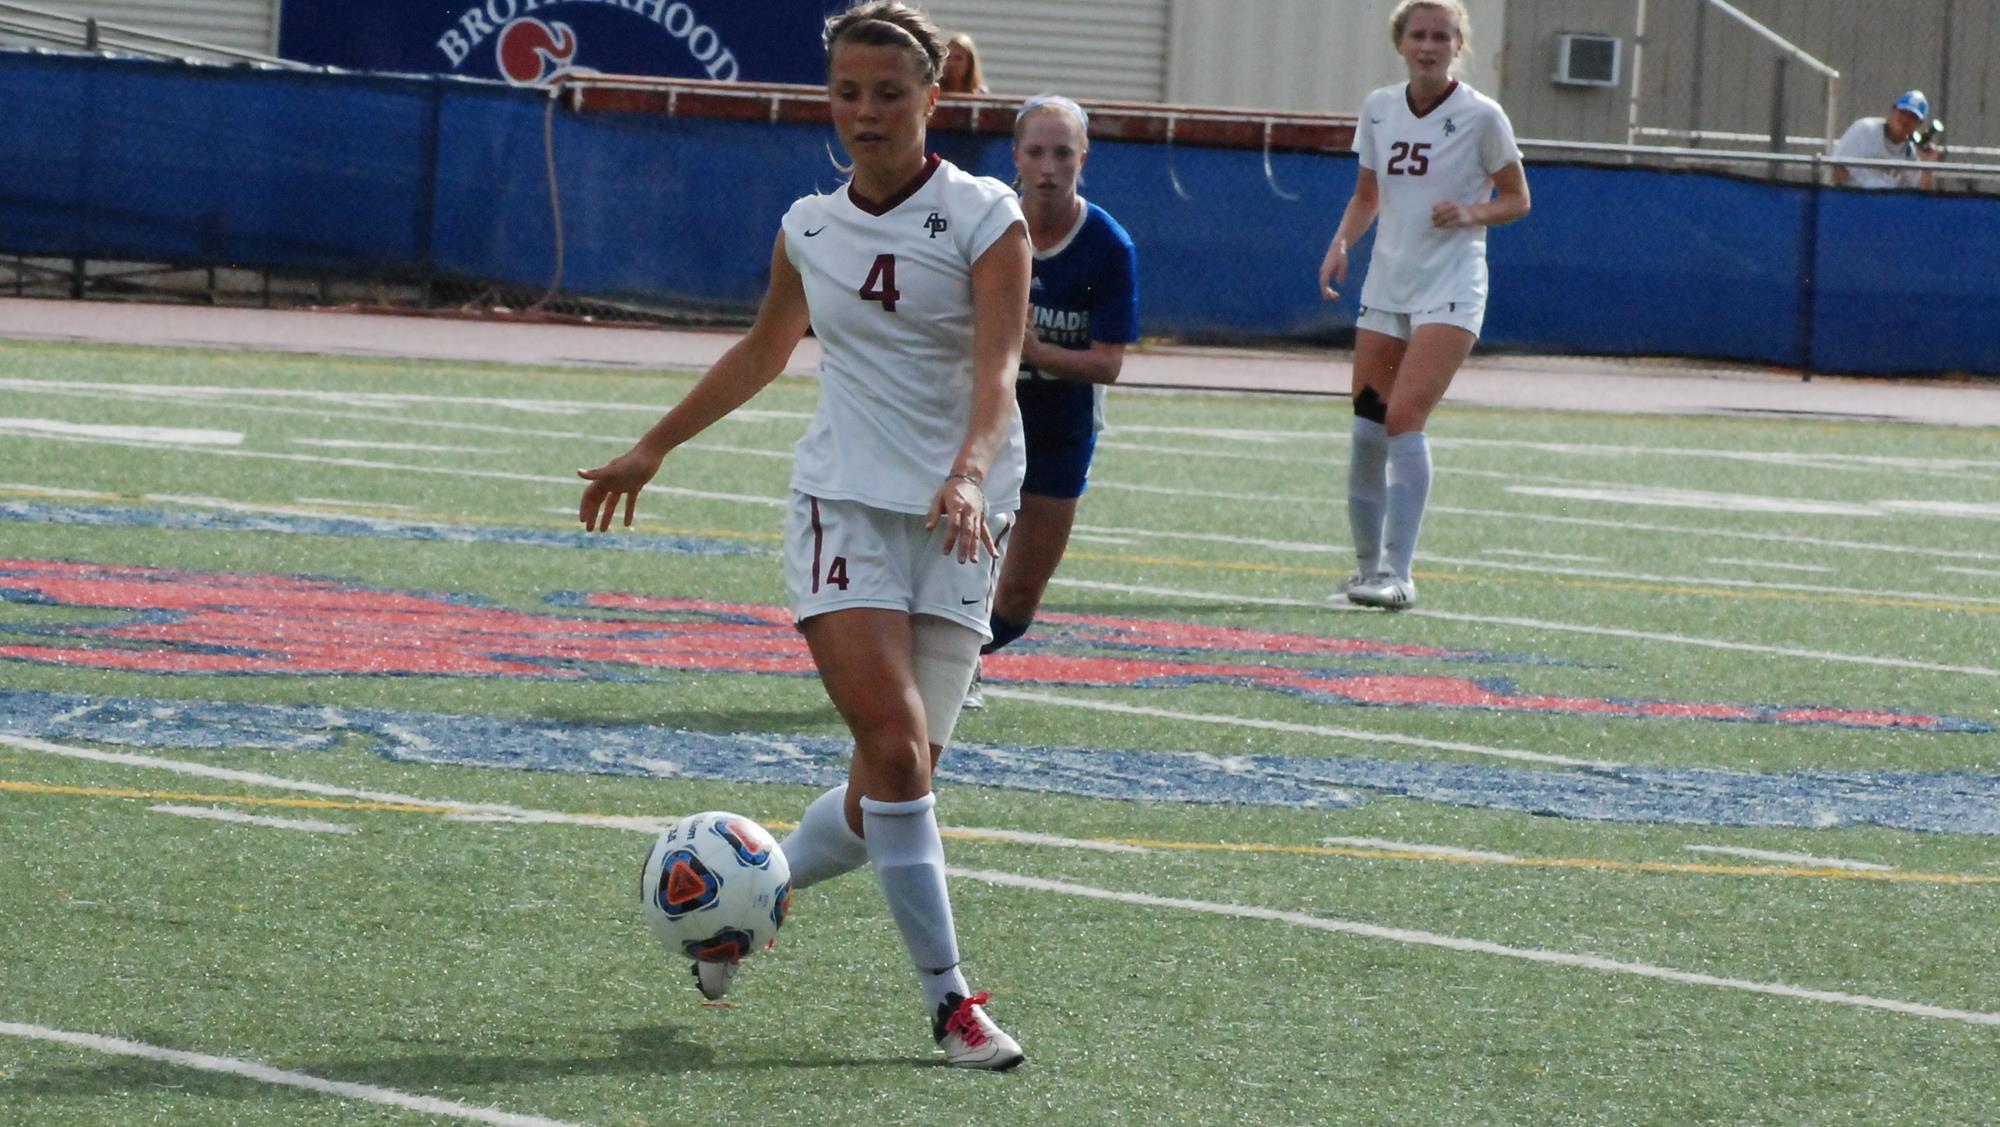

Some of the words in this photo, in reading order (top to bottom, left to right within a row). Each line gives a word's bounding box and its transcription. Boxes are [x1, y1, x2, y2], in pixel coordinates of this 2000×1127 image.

[437, 0, 740, 82] BROHOOD
[1387, 141, 1432, 176] 25
[859, 253, 900, 312] 4
[826, 556, 850, 591] 4
